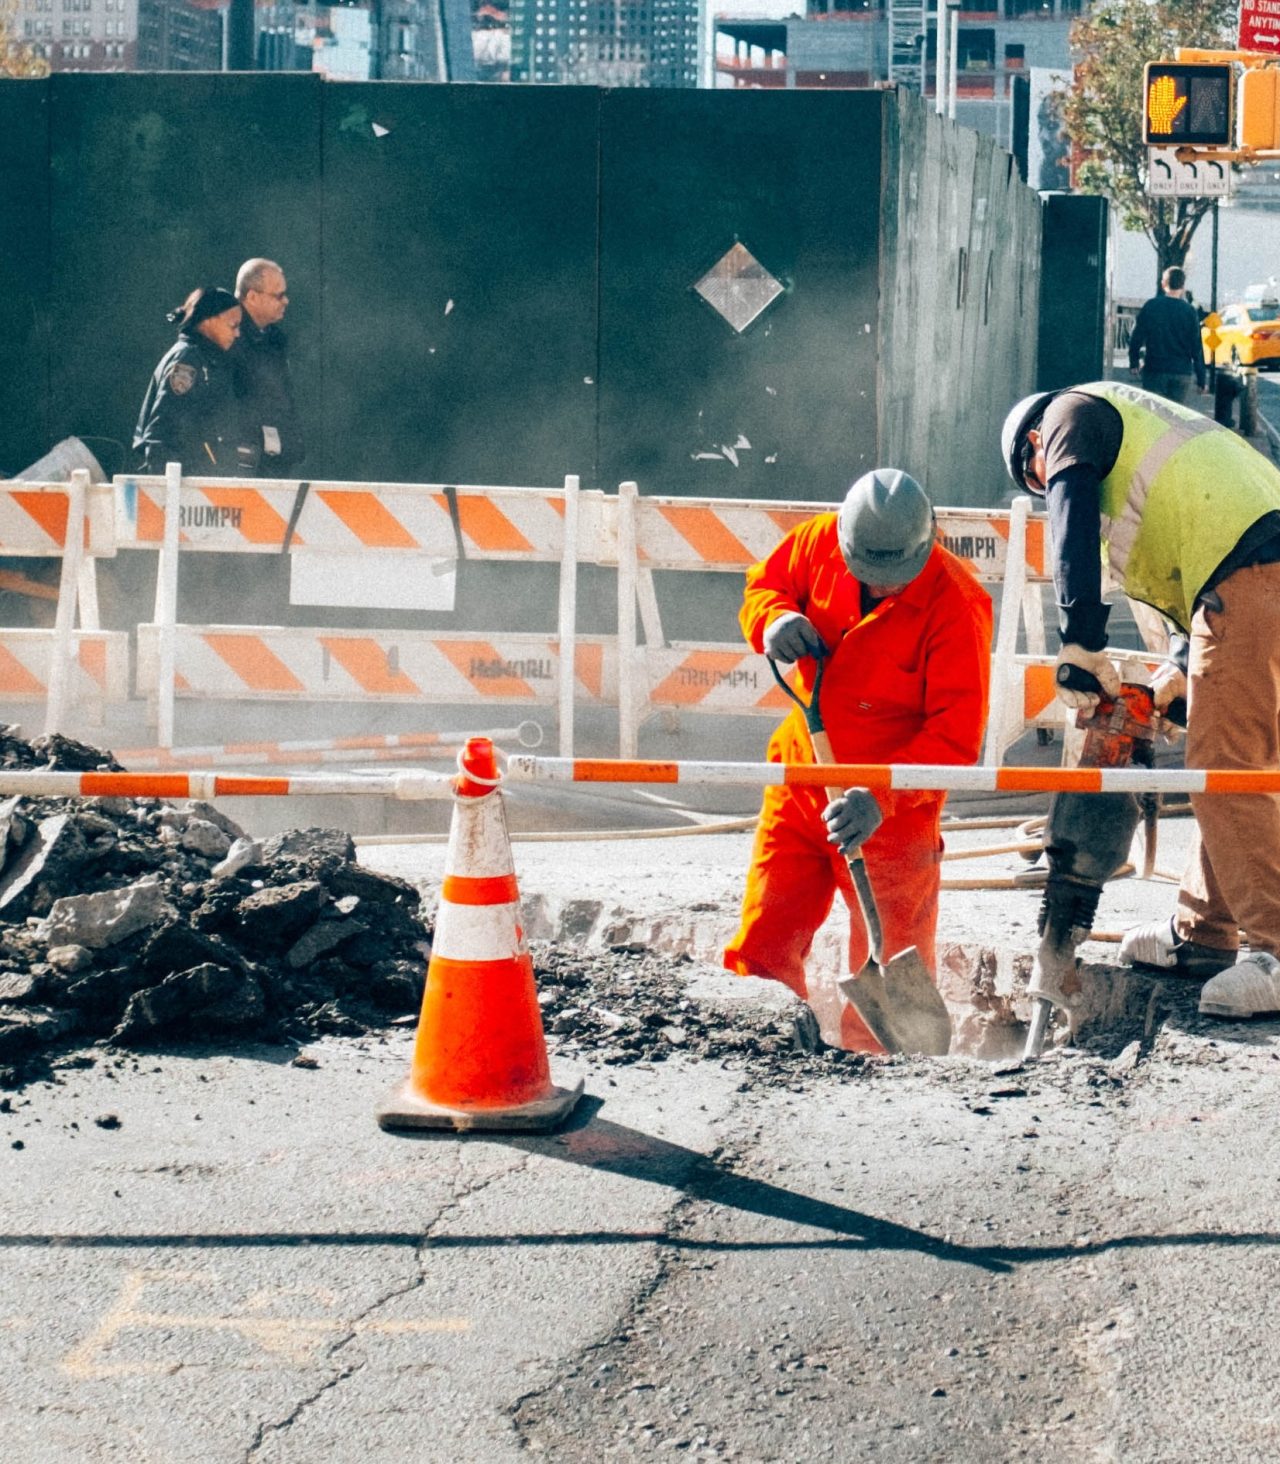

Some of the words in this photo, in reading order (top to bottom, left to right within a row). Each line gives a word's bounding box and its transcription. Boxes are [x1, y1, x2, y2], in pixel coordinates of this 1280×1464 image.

[1244, 0, 1256, 11] NO
[1153, 182, 1173, 191] ONLY
[1179, 182, 1199, 190] ONLY
[162, 505, 243, 528] RIUMPH
